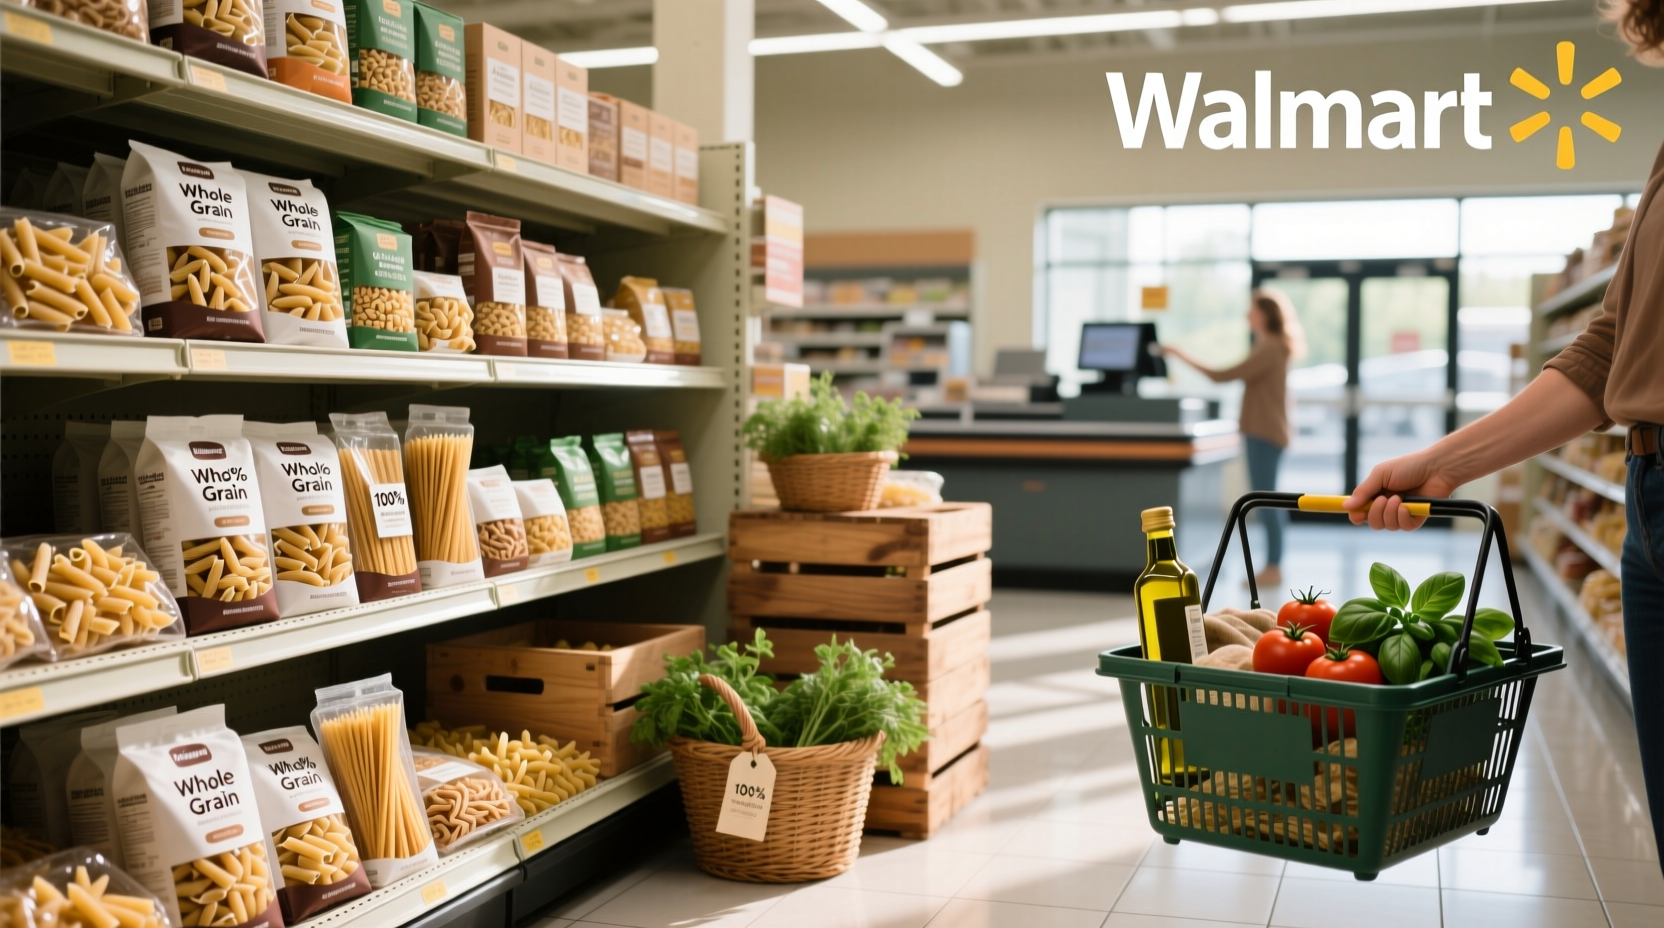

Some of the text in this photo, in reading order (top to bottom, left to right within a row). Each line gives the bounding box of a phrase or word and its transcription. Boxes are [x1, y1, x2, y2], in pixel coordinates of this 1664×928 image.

[178, 182, 233, 204] Whole
[190, 200, 234, 219] Grain
[270, 198, 319, 217] Whole
[281, 213, 322, 232] Grain
[202, 483, 248, 502] Grain
[291, 476, 333, 493] Grain
[373, 490, 406, 508] 100%
[173, 769, 235, 798] Whole
[280, 771, 323, 791] Grain
[735, 783, 765, 800] 100%
[189, 790, 241, 816] Grain
